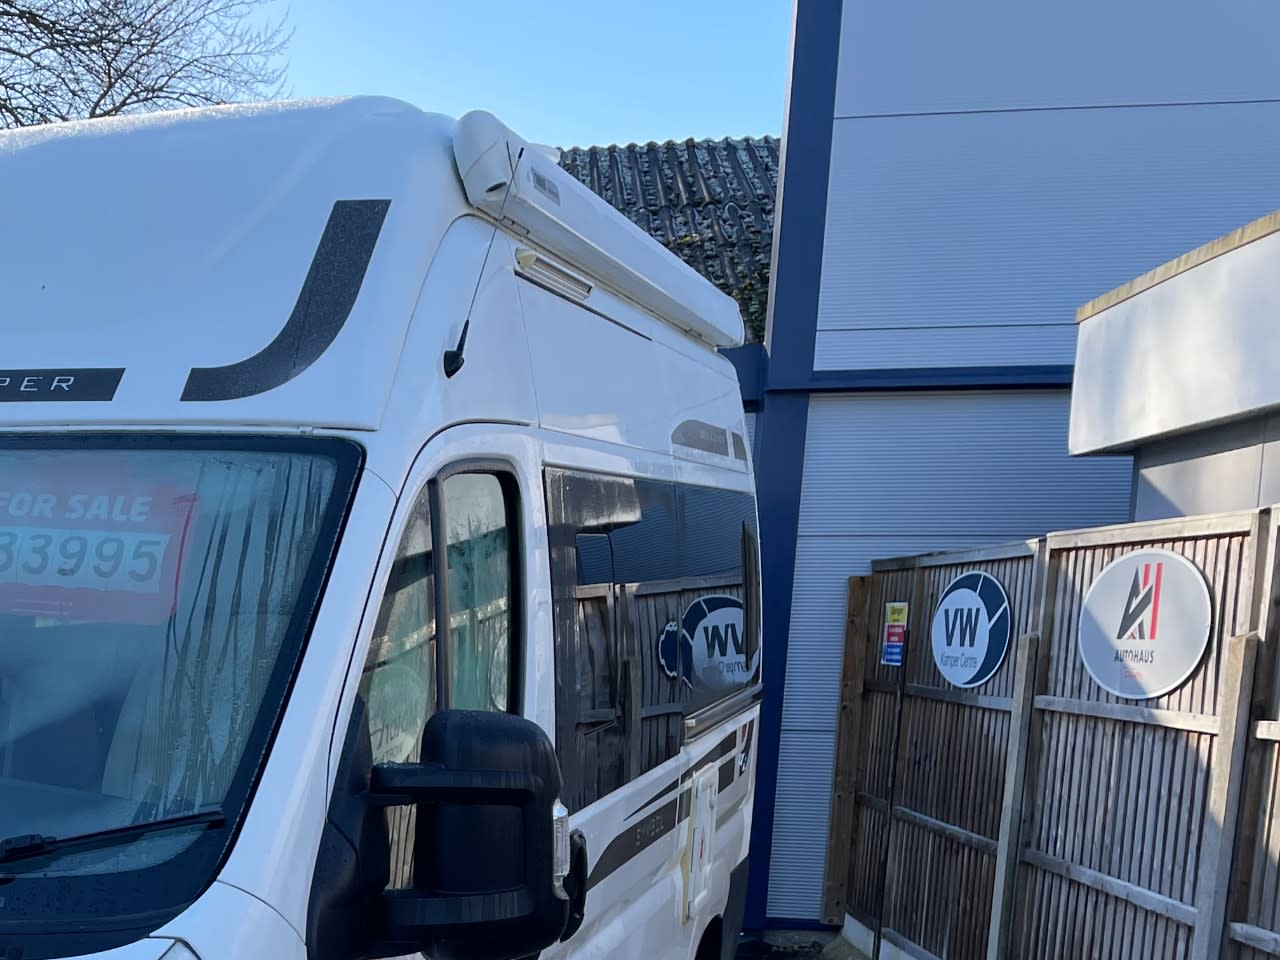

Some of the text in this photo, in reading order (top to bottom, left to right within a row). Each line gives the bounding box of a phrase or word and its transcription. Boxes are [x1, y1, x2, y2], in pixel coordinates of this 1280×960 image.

[64, 494, 153, 522] SALE
[944, 607, 981, 648] VW
[1114, 649, 1155, 664] AUTOHAUS
